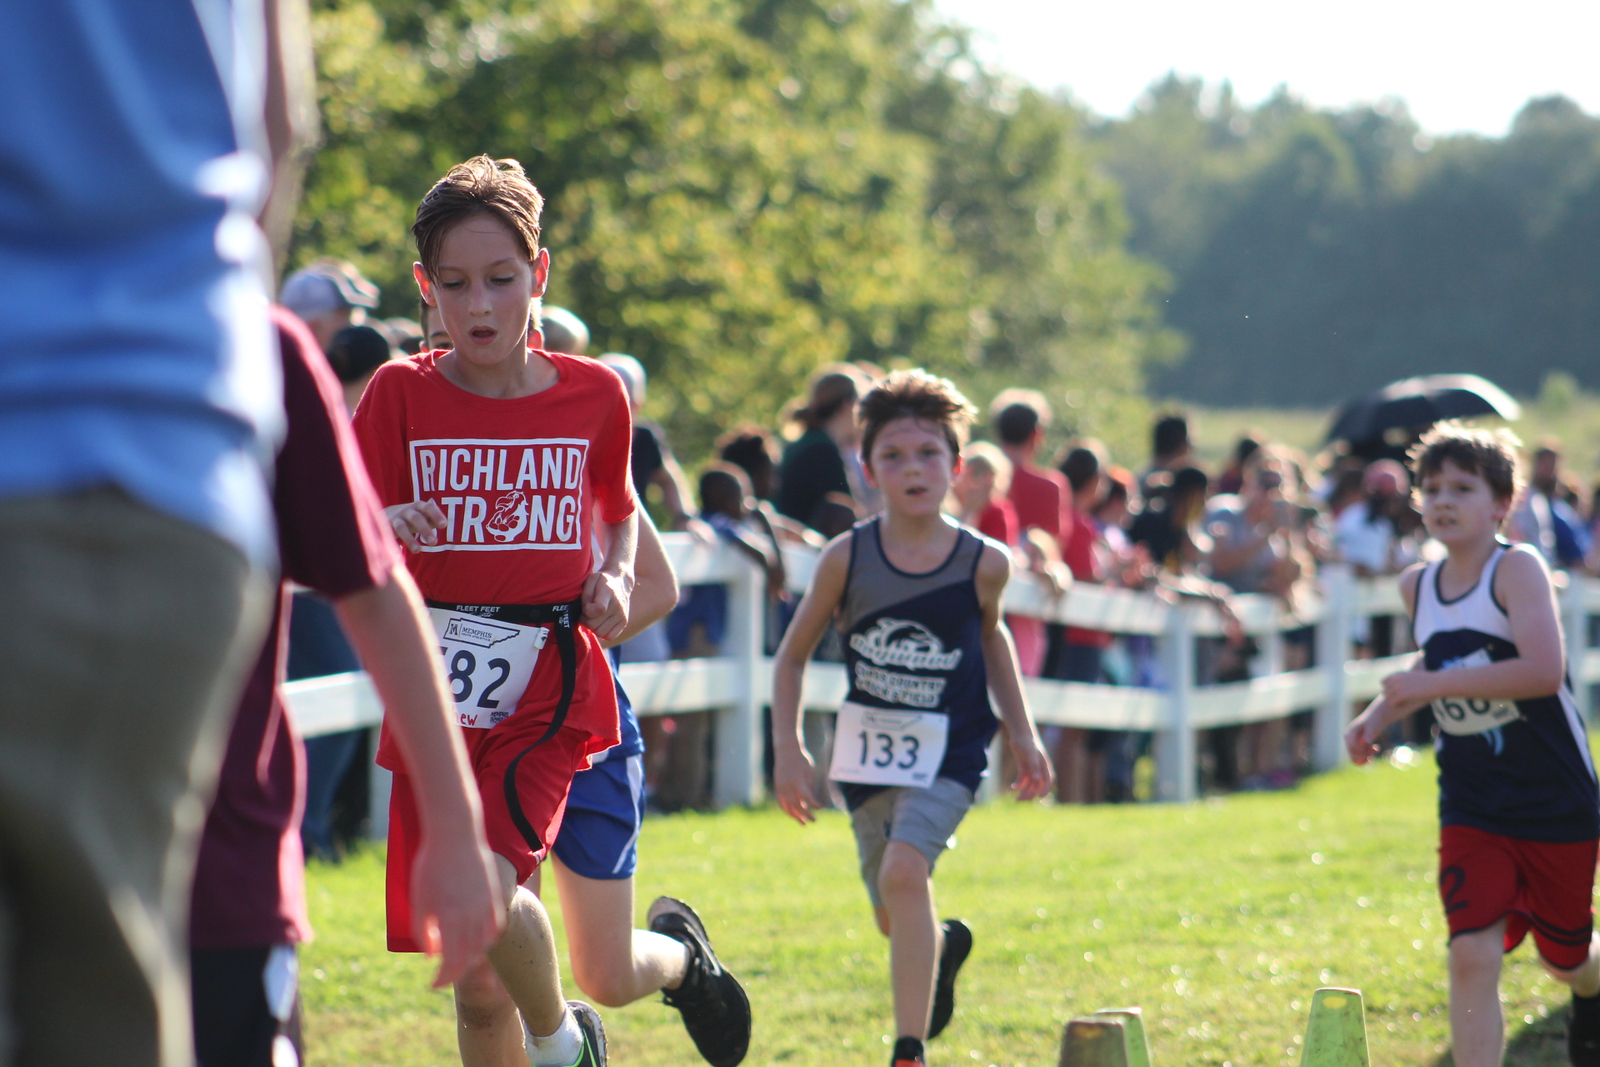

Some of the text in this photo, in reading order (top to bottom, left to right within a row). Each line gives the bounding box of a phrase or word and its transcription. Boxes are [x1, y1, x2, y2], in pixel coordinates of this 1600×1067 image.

[419, 447, 582, 492] RICHLAND
[456, 604, 501, 613] FLEET FEET
[461, 626, 493, 639] MEMPHIS
[440, 646, 511, 709] 82
[858, 730, 920, 770] 133
[1440, 864, 1469, 916] 2
